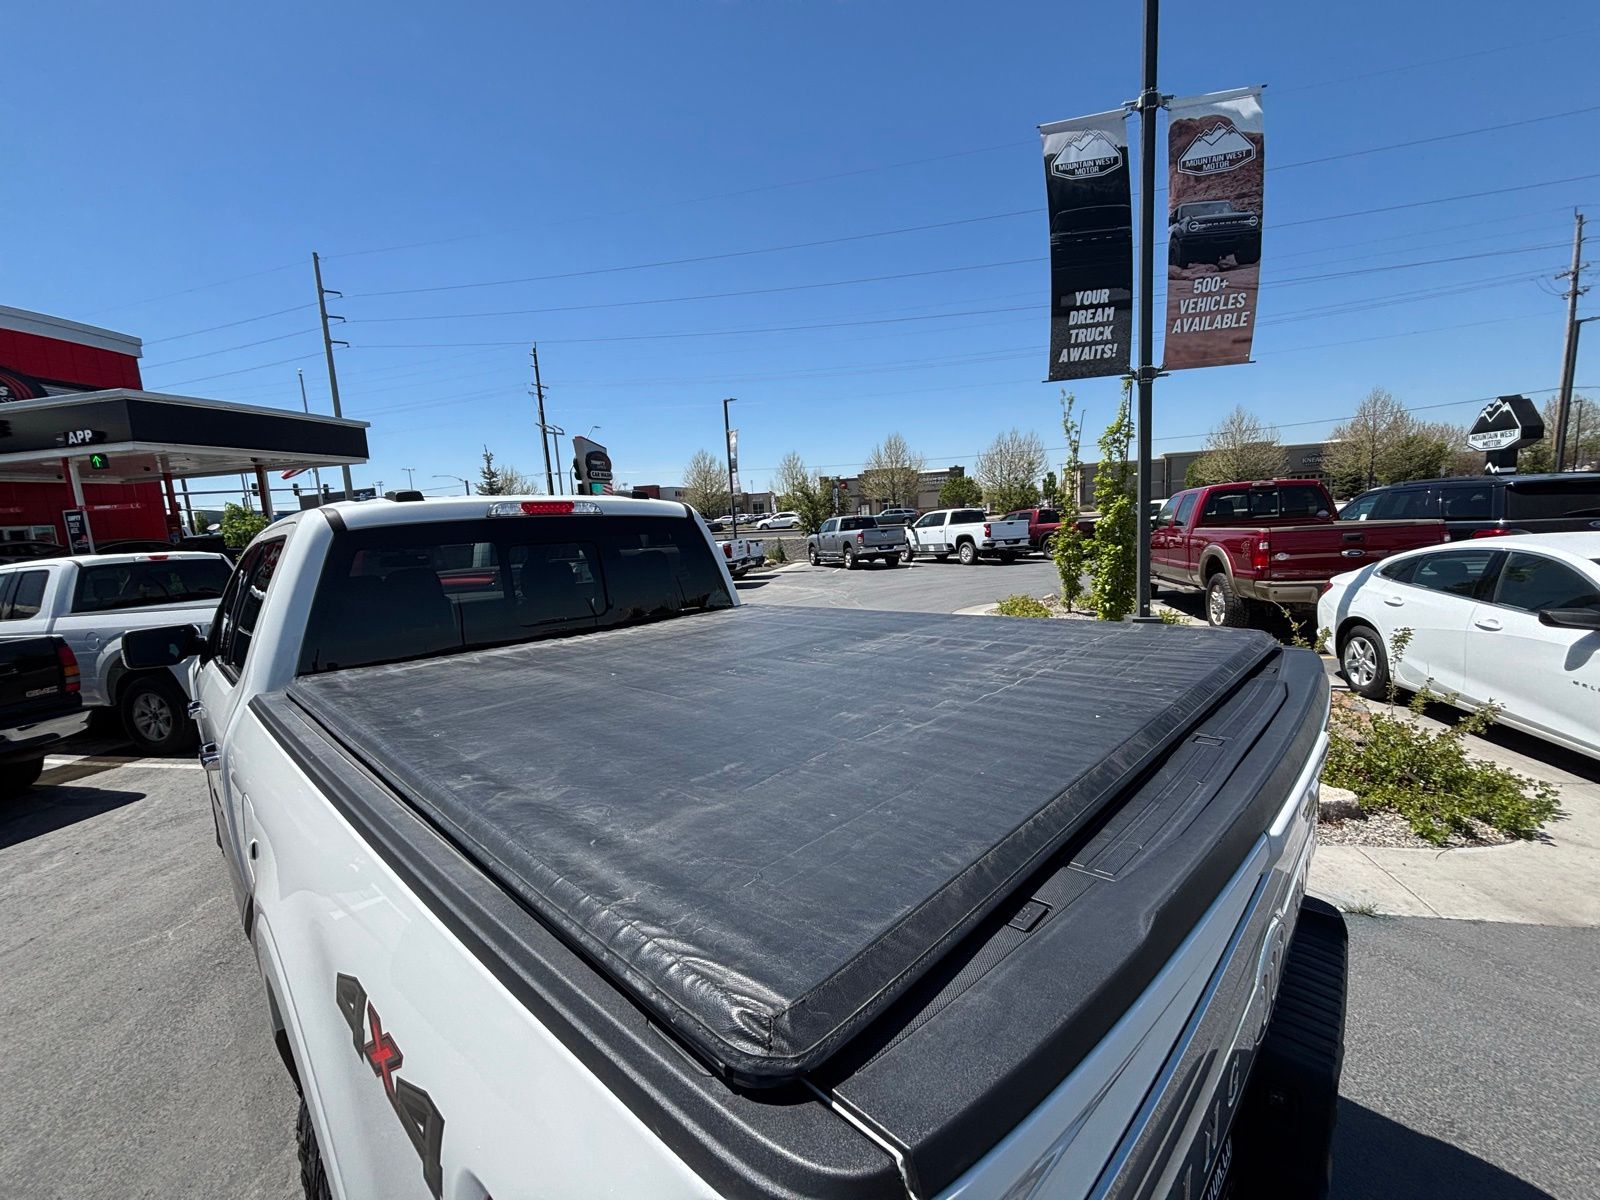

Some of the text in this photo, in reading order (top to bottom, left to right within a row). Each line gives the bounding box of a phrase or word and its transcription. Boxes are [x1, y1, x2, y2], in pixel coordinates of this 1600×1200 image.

[1058, 157, 1115, 171] MOUNTAIN WEST
[1185, 150, 1247, 168] MOUNTAIN WEST
[1202, 160, 1230, 171] MOTOR
[1074, 165, 1100, 176] MOTOR
[1193, 276, 1230, 294] 500+
[1075, 288, 1110, 307] YOUR
[1179, 292, 1248, 315] VEHICLES
[1068, 306, 1116, 326] DREAM
[1171, 311, 1251, 334] AVAILABLE
[1069, 325, 1114, 344] TRUCK
[1058, 343, 1118, 363] AWAITS!
[68, 429, 93, 445] APP
[1471, 430, 1517, 441] MOUNTAIN WEST
[1482, 439, 1502, 448] MOTOR
